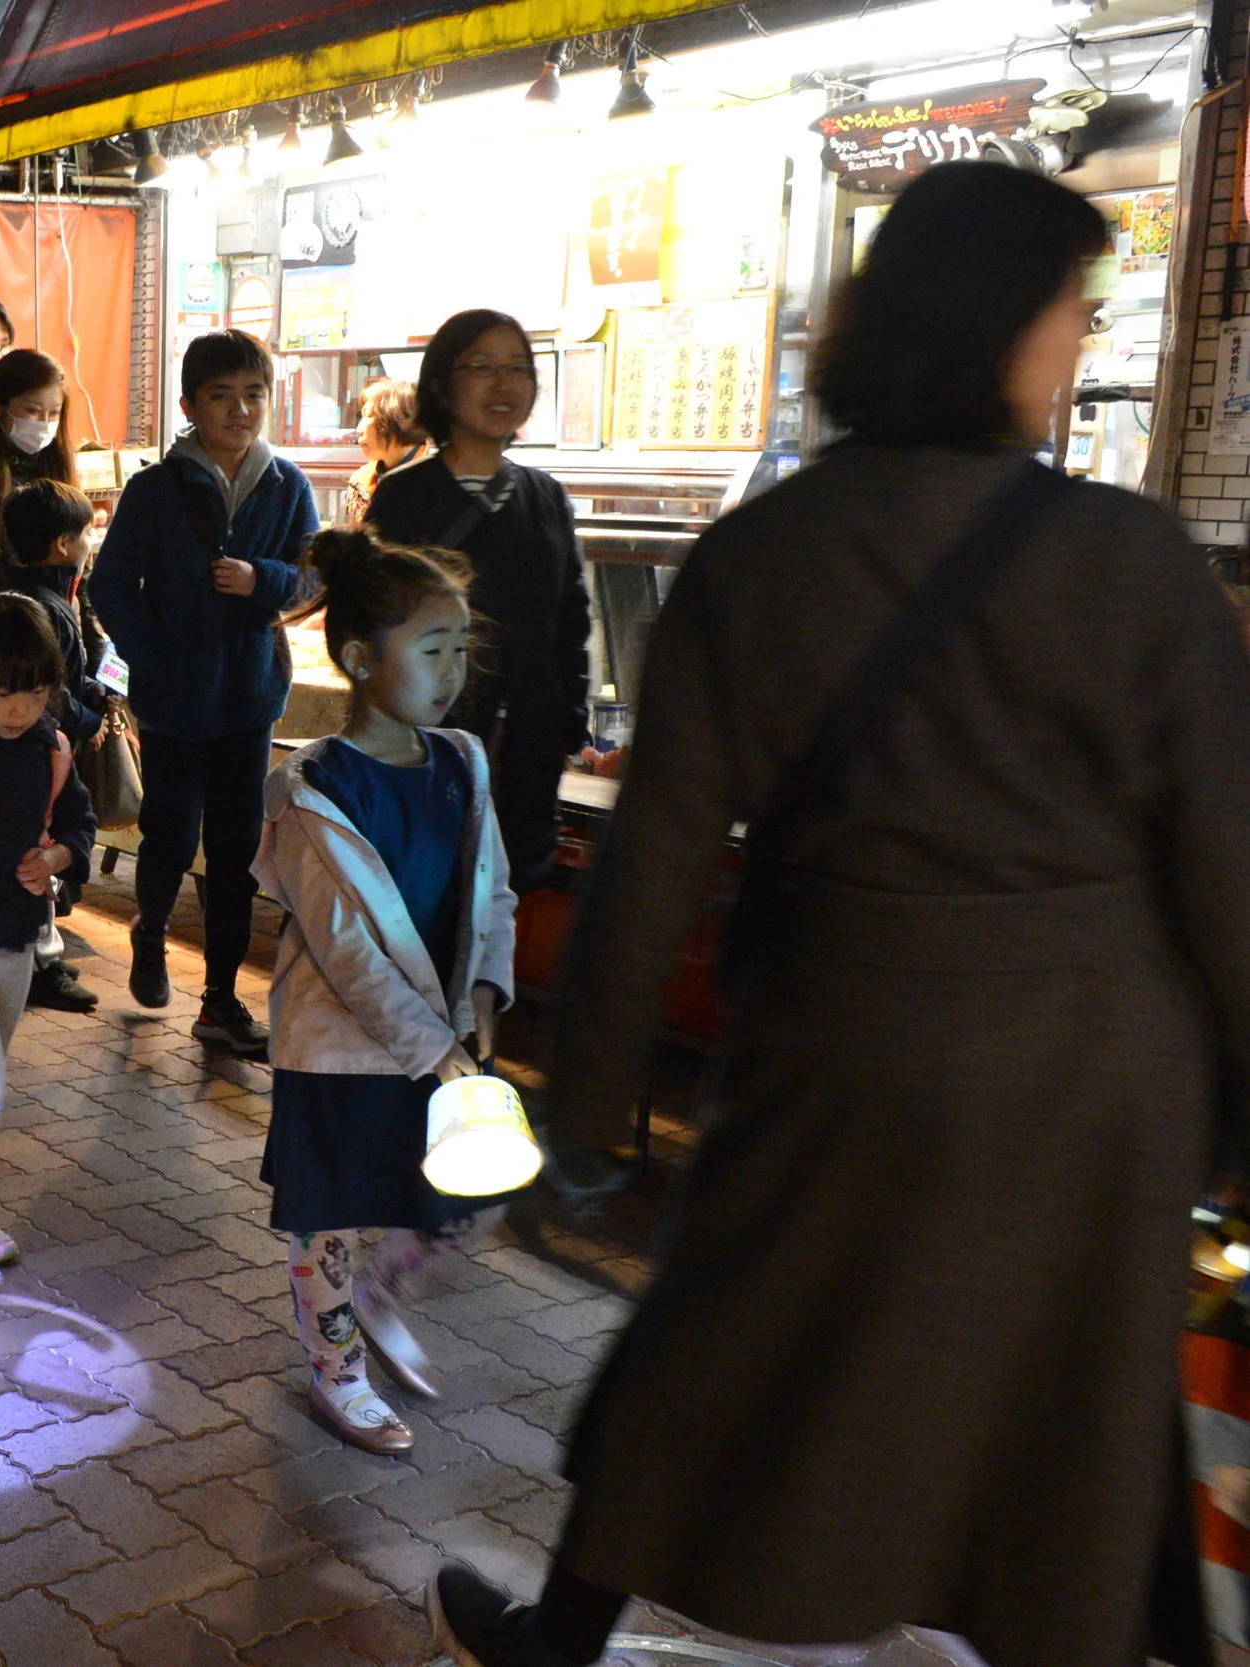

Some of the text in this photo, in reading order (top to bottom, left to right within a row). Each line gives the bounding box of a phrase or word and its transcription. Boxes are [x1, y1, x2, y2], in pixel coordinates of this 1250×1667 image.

[929, 96, 1007, 122] WELCOME!
[693, 347, 712, 439] とんかつ弁当
[717, 345, 737, 439] 豚焼肉弁当
[739, 345, 761, 439] しゃけ弁当
[1072, 436, 1090, 456] 30
